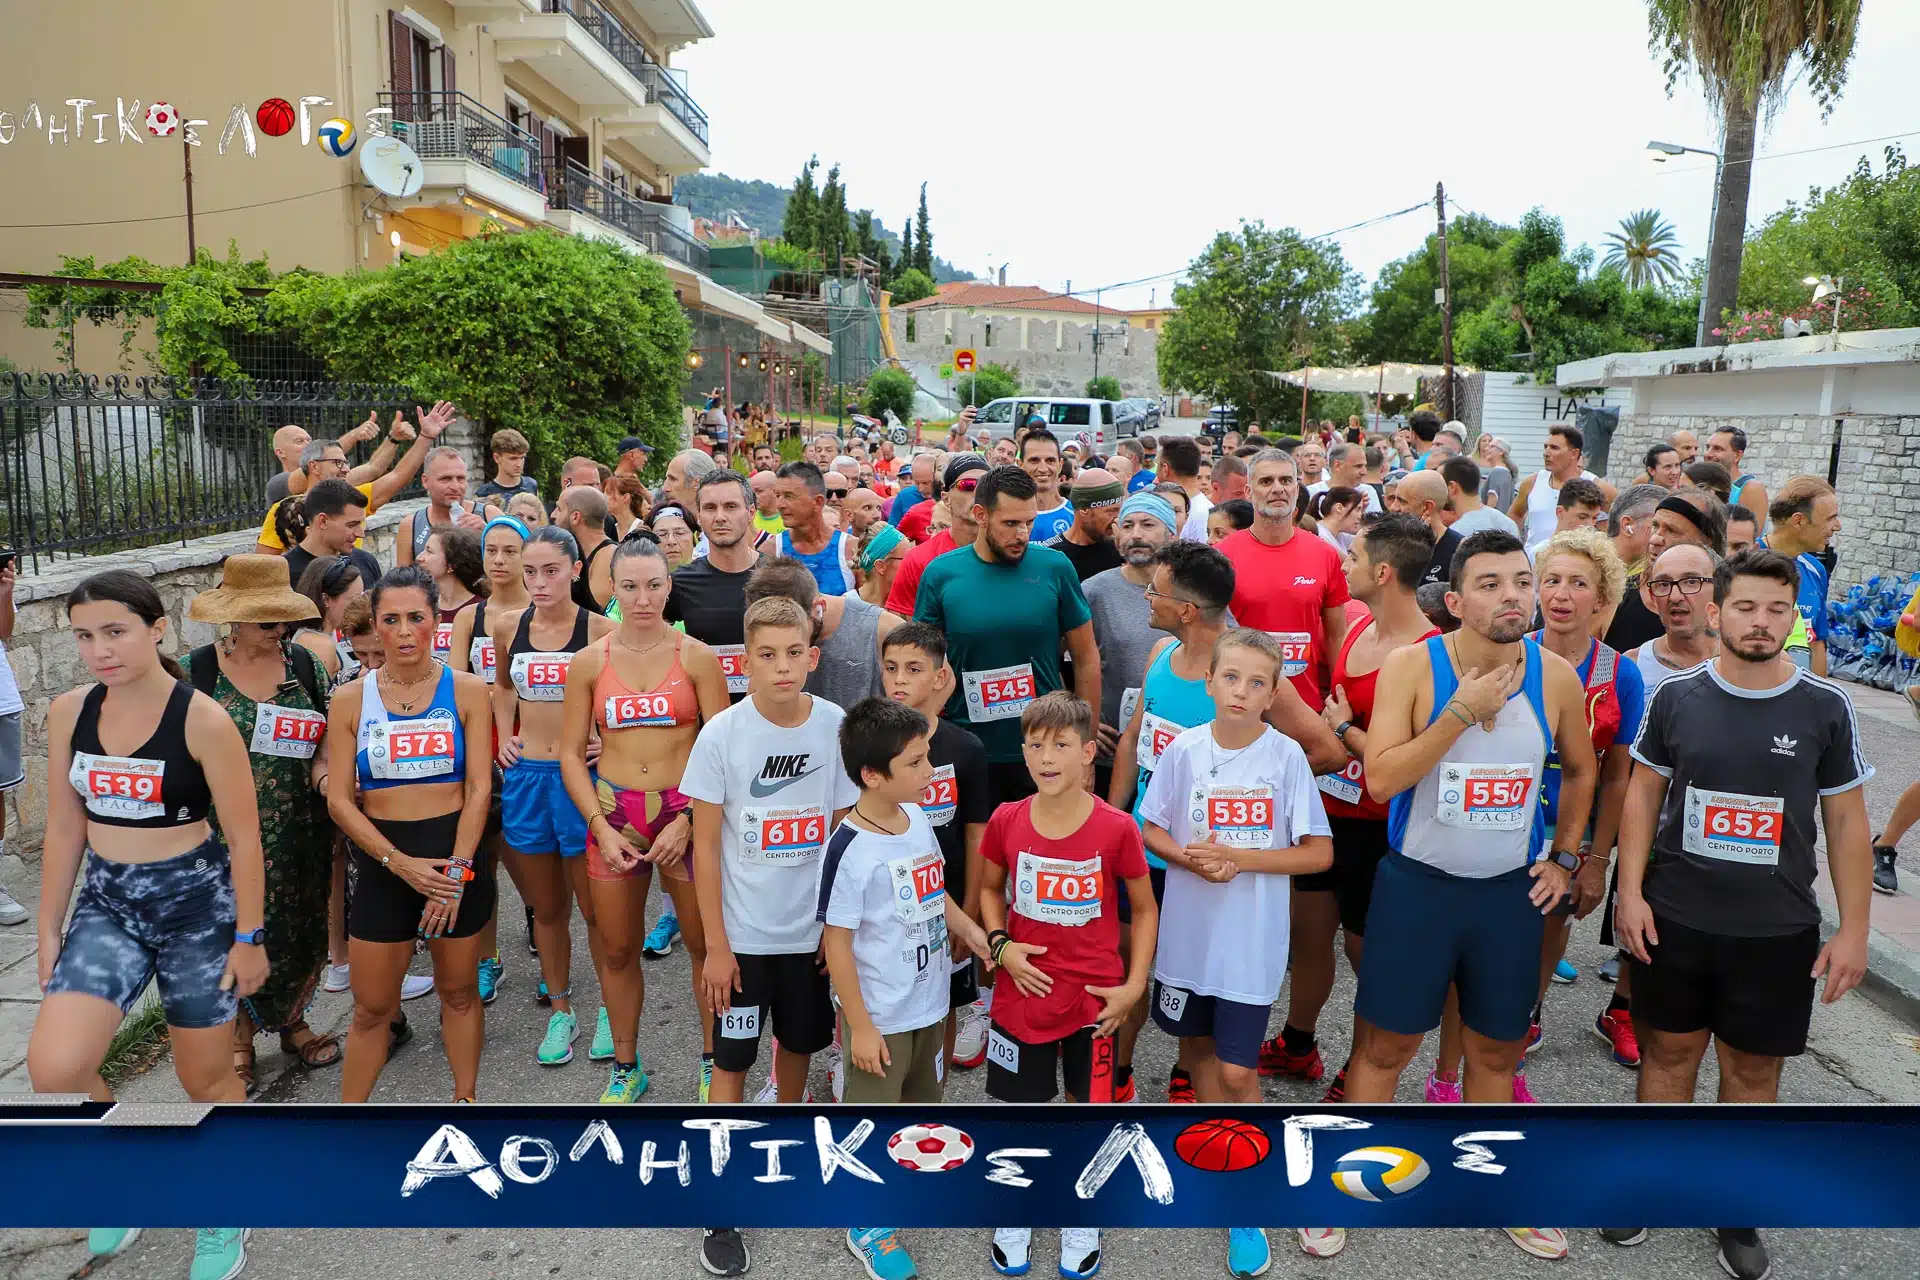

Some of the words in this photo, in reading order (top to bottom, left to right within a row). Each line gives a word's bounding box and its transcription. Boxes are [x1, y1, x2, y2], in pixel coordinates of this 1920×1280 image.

[1543, 397, 1605, 420] HA
[1282, 644, 1307, 660] 57
[533, 664, 569, 683] 55
[1284, 663, 1306, 671] CES
[533, 688, 564, 696] FAC
[986, 678, 1031, 701] 545
[621, 696, 669, 719] 630
[988, 702, 1026, 715] FACE
[279, 718, 320, 740] 518
[396, 733, 449, 757] 573
[1770, 747, 1796, 757] adidas
[396, 759, 452, 772] FACES
[760, 753, 811, 779] NIKE
[95, 774, 154, 800] 539
[922, 781, 952, 805] 02
[1320, 775, 1359, 796] FACES
[1471, 780, 1525, 805] 550
[932, 809, 954, 819] PORTO
[1213, 801, 1268, 824] 538
[1468, 811, 1523, 822] FACES
[768, 819, 820, 844] 616
[1711, 811, 1775, 838] 652
[797, 848, 820, 857] PORTO
[1707, 842, 1744, 853] CENTRO
[1745, 845, 1774, 856] PORTO
[1043, 874, 1097, 900] 703
[1040, 906, 1073, 915] CENTRO
[1074, 905, 1099, 915] PORTO
[1161, 987, 1180, 1011] 538
[726, 1014, 755, 1030] 616
[992, 1038, 1014, 1063] 703
